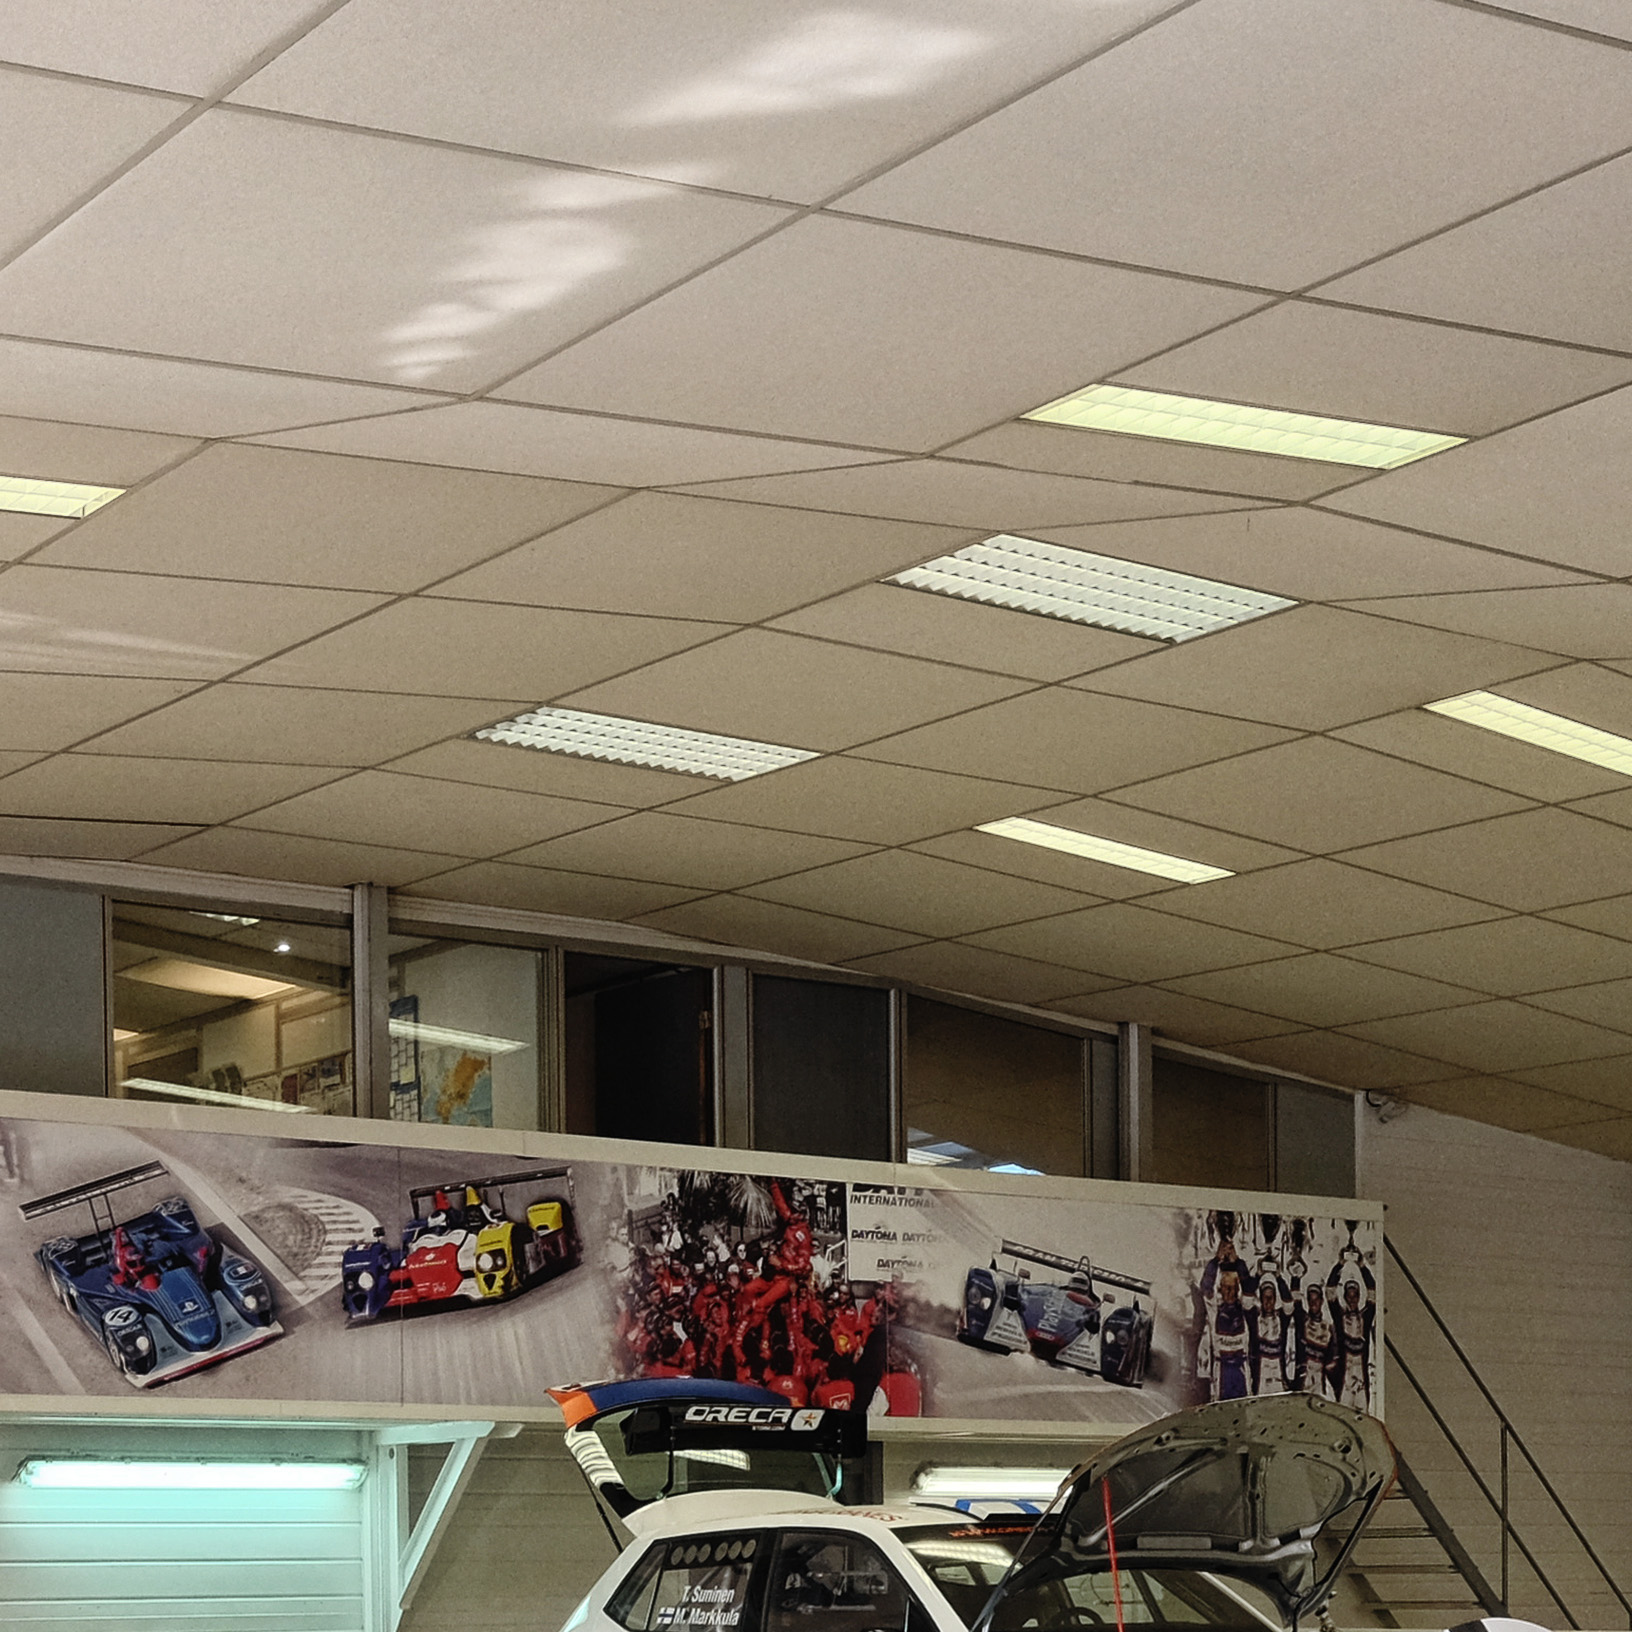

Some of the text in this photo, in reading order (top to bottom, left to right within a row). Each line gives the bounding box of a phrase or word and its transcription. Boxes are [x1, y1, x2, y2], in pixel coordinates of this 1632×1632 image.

[850, 1194, 935, 1209] INTERNATIONAL
[107, 1308, 133, 1323] 14
[685, 1406, 793, 1424] ORECA
[673, 1607, 740, 1626] M. Markkula
